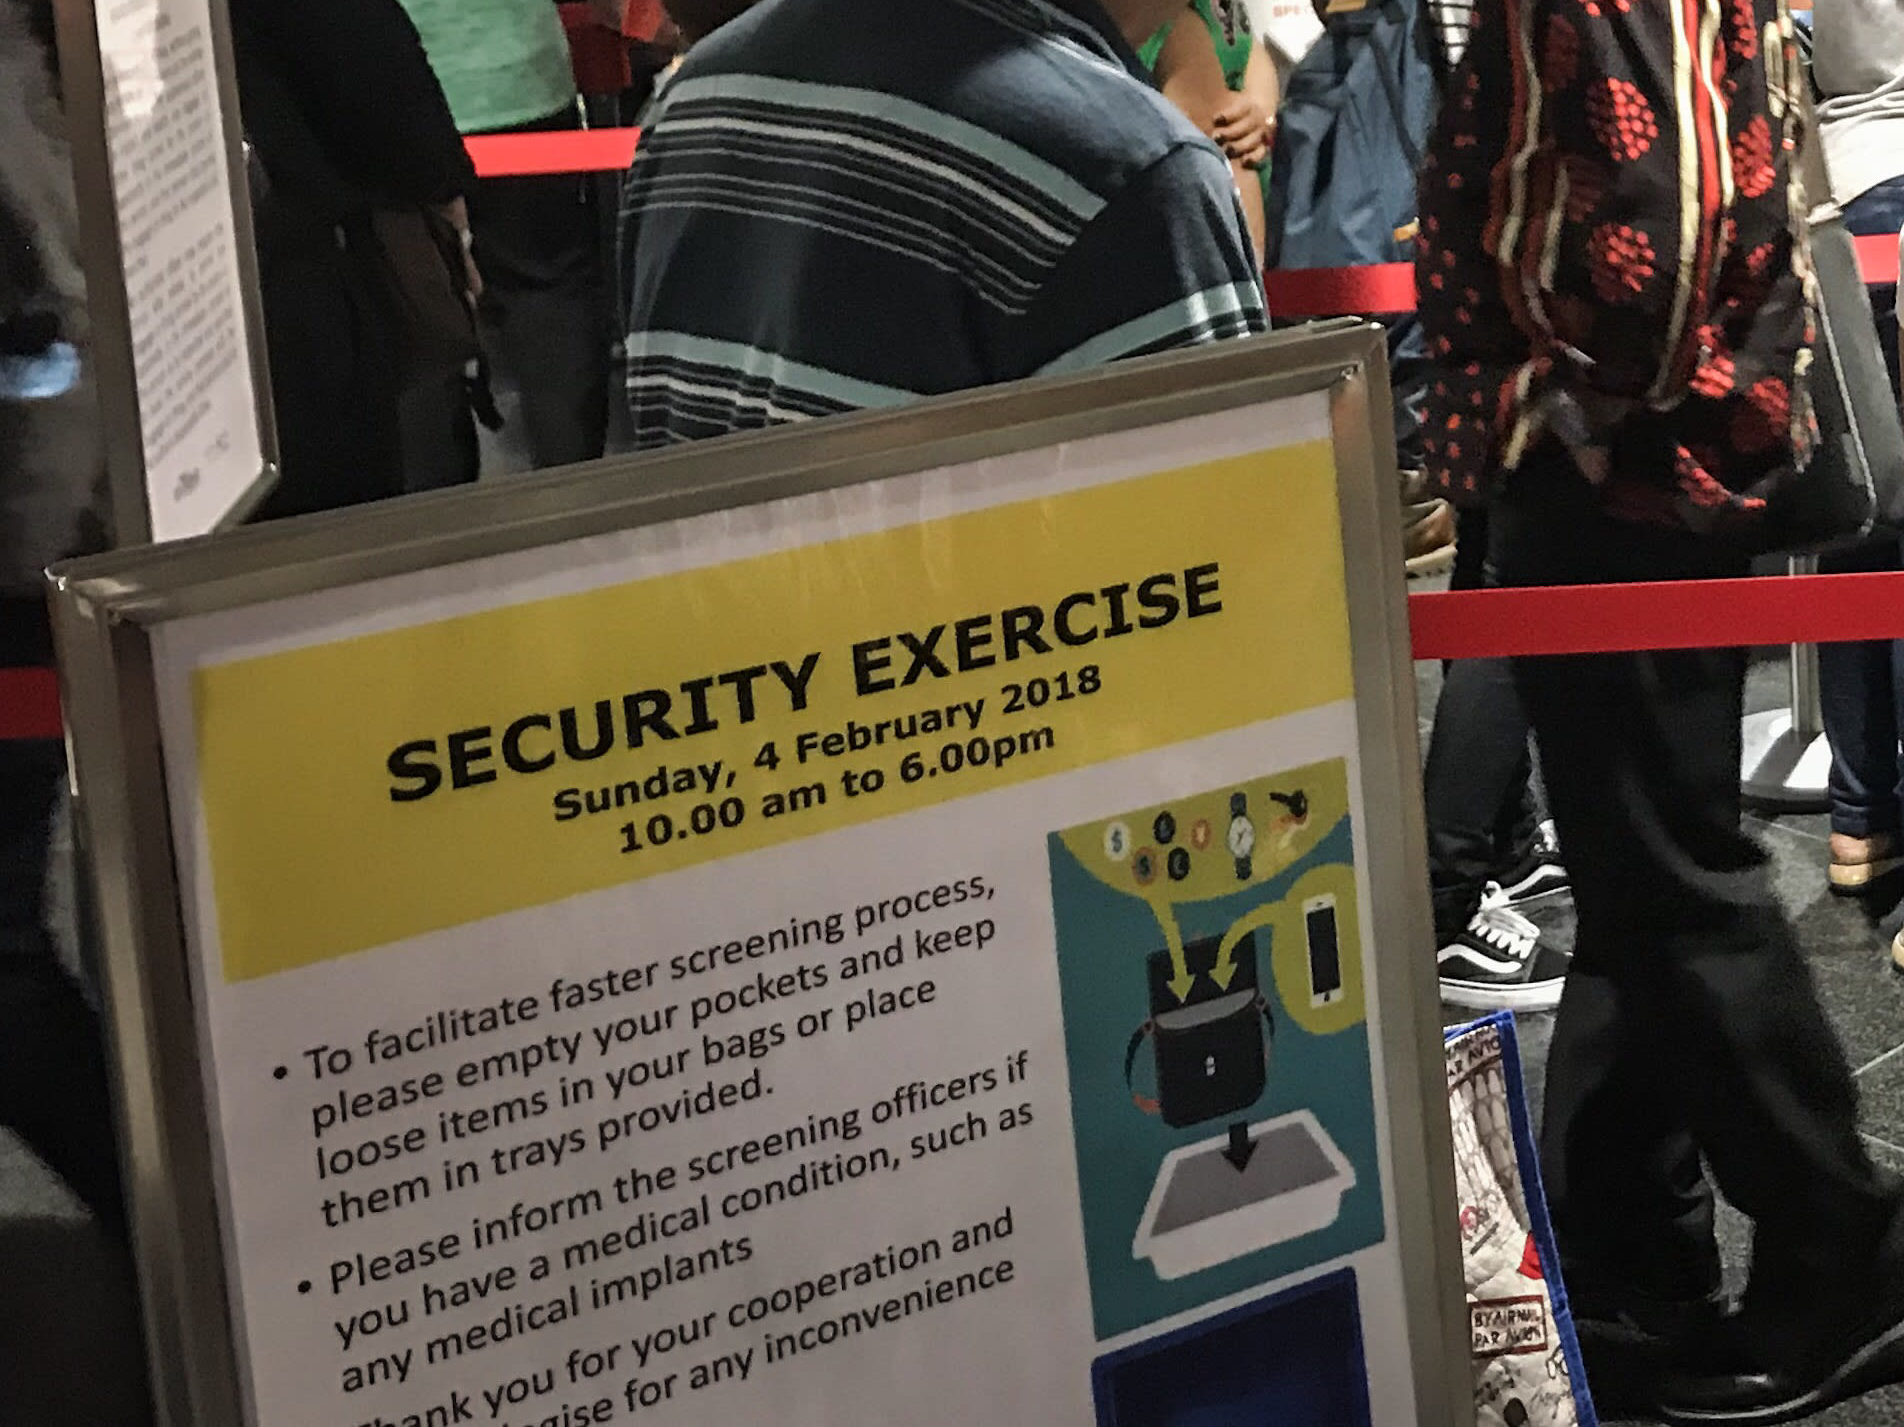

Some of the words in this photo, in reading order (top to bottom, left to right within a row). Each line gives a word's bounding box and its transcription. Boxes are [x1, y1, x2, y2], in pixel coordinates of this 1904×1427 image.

[385, 651, 822, 803] SECURITY
[851, 561, 1223, 698] EXERCISE
[551, 759, 737, 823] Sunday,
[752, 741, 782, 772] 4
[795, 697, 985, 765] February
[1000, 664, 1102, 716] 2018
[619, 796, 746, 855] 10.00
[761, 781, 827, 820] am
[840, 768, 885, 799] to
[899, 726, 1056, 784] 6.00pm
[302, 1044, 353, 1080] To
[363, 996, 540, 1065] facilitate
[548, 961, 660, 1013] faster
[669, 912, 846, 981] screening
[854, 875, 995, 938] process,
[311, 1072, 444, 1139] please
[455, 1031, 583, 1088] empty
[592, 1004, 679, 1057] your
[690, 963, 829, 1030] pockets
[839, 933, 904, 981] and
[914, 918, 996, 960] keep
[316, 1127, 427, 1181] loose
[438, 1090, 549, 1144] items
[559, 1076, 595, 1108] in
[605, 1048, 691, 1101] your
[701, 1022, 787, 1067] bags
[796, 1007, 834, 1039] or
[845, 980, 936, 1033] place
[320, 1175, 431, 1228] them
[443, 1160, 480, 1192] in
[490, 1128, 587, 1176] trays
[597, 1066, 774, 1153] provided.
[329, 1233, 461, 1296] Please
[472, 1188, 603, 1250] inform
[612, 1166, 677, 1205] the
[687, 1108, 863, 1182] screening
[871, 1067, 998, 1125] officers
[1006, 1049, 1029, 1085] if
[333, 1299, 409, 1352] you
[422, 1266, 517, 1317] have
[529, 1255, 551, 1282] a
[562, 1193, 711, 1271] medical
[721, 1147, 901, 1219] condition,
[910, 1111, 988, 1160] such
[999, 1102, 1034, 1132] as
[342, 1348, 413, 1393] any
[426, 1284, 580, 1365] medical
[590, 1236, 753, 1310] implants
[482, 1368, 555, 1420] you
[565, 1344, 622, 1384] for
[631, 1311, 717, 1369] your
[727, 1238, 942, 1329] cooperation
[951, 1205, 1014, 1253] and
[623, 1373, 678, 1413] for
[689, 1347, 754, 1391] any
[764, 1259, 1015, 1364] inconvenience
